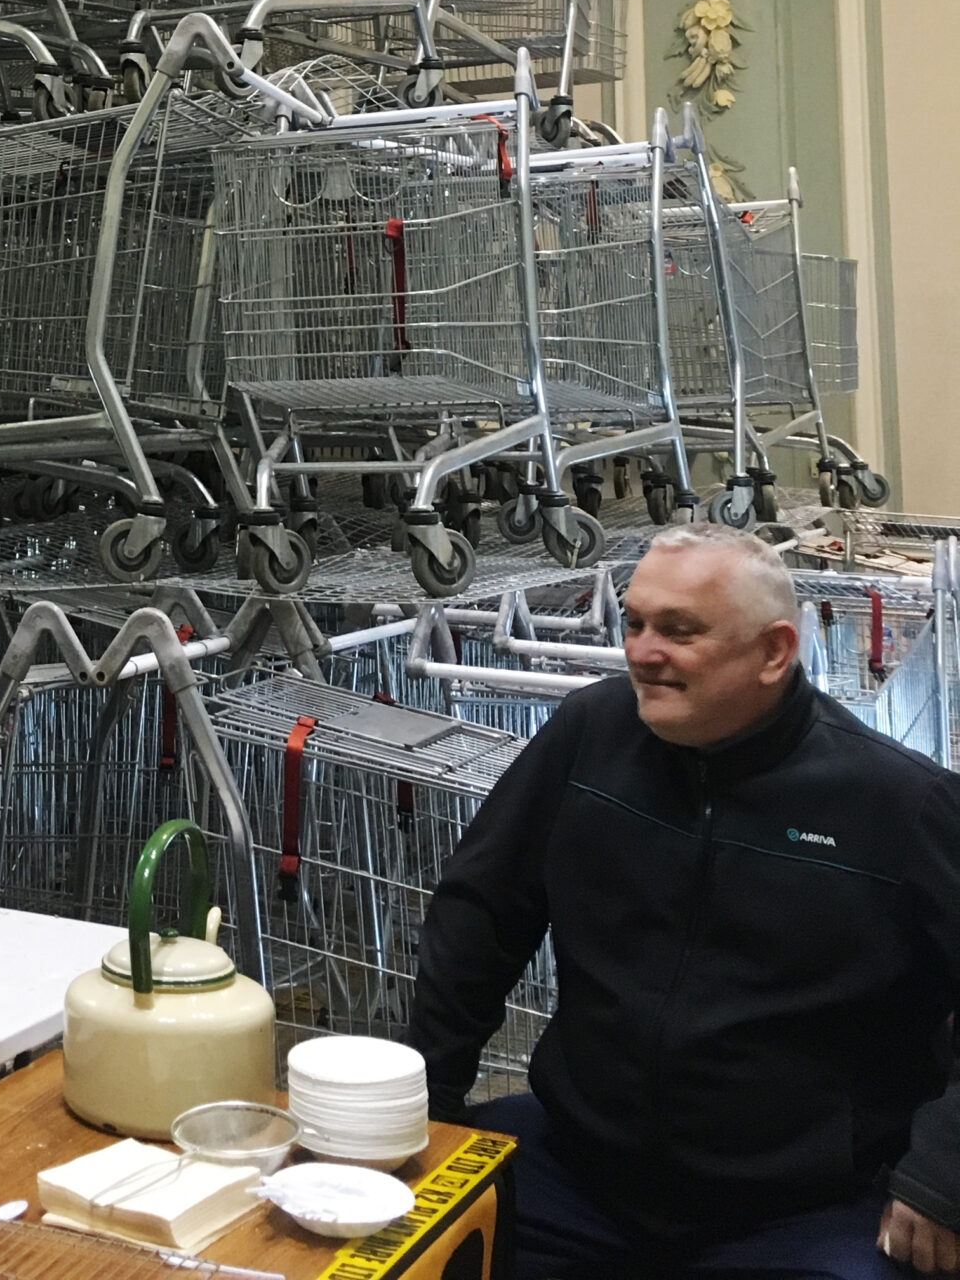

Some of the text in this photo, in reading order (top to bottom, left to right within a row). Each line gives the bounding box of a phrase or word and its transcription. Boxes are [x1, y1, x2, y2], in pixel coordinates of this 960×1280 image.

[800, 832, 836, 847] ARRIVA
[446, 1157, 488, 1175] LTD
[415, 1188, 456, 1205] K2
